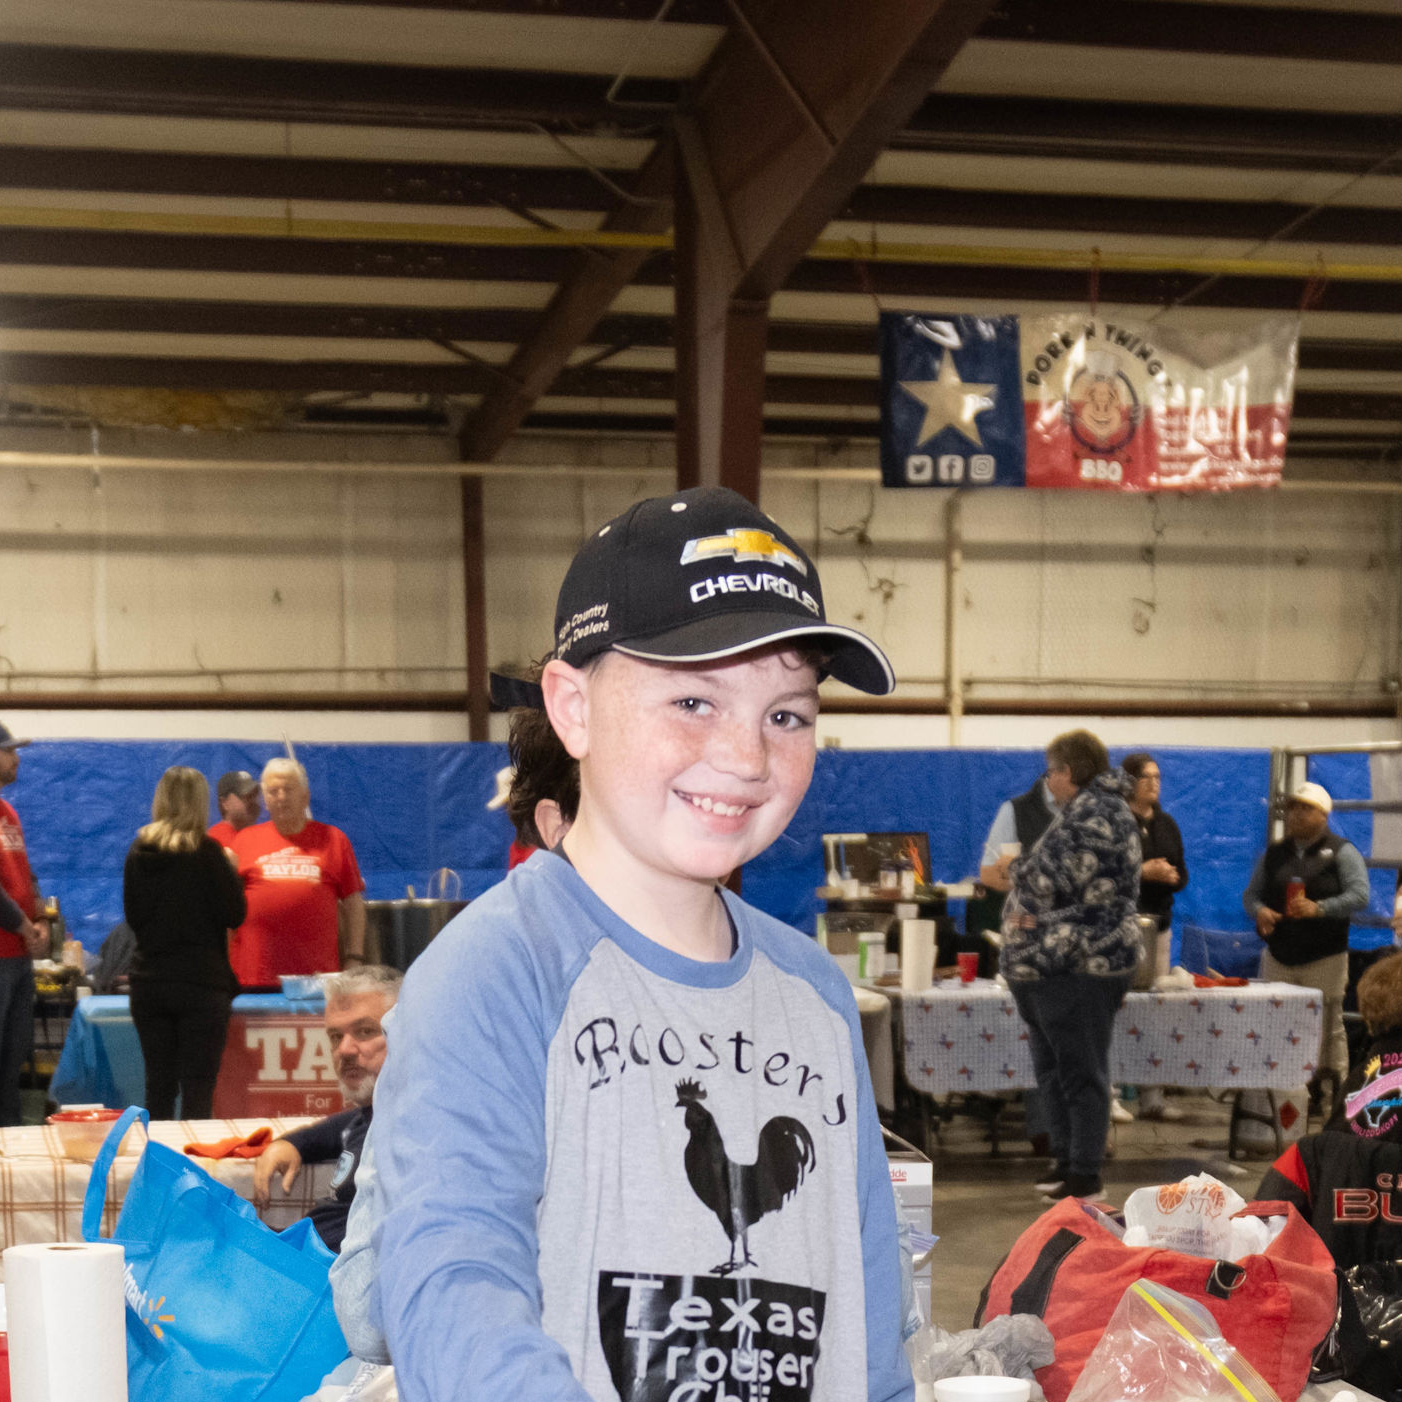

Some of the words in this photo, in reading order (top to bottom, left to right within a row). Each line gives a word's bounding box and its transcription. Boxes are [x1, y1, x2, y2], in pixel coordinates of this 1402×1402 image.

[1026, 331, 1074, 386] PORK
[1105, 323, 1173, 388] THING
[1080, 458, 1123, 482] BBQ
[571, 602, 608, 627] Country
[689, 572, 820, 618] CHEVROLET
[573, 620, 609, 642] Dealers
[612, 1276, 819, 1341] Texas
[624, 1330, 813, 1389] Trouser
